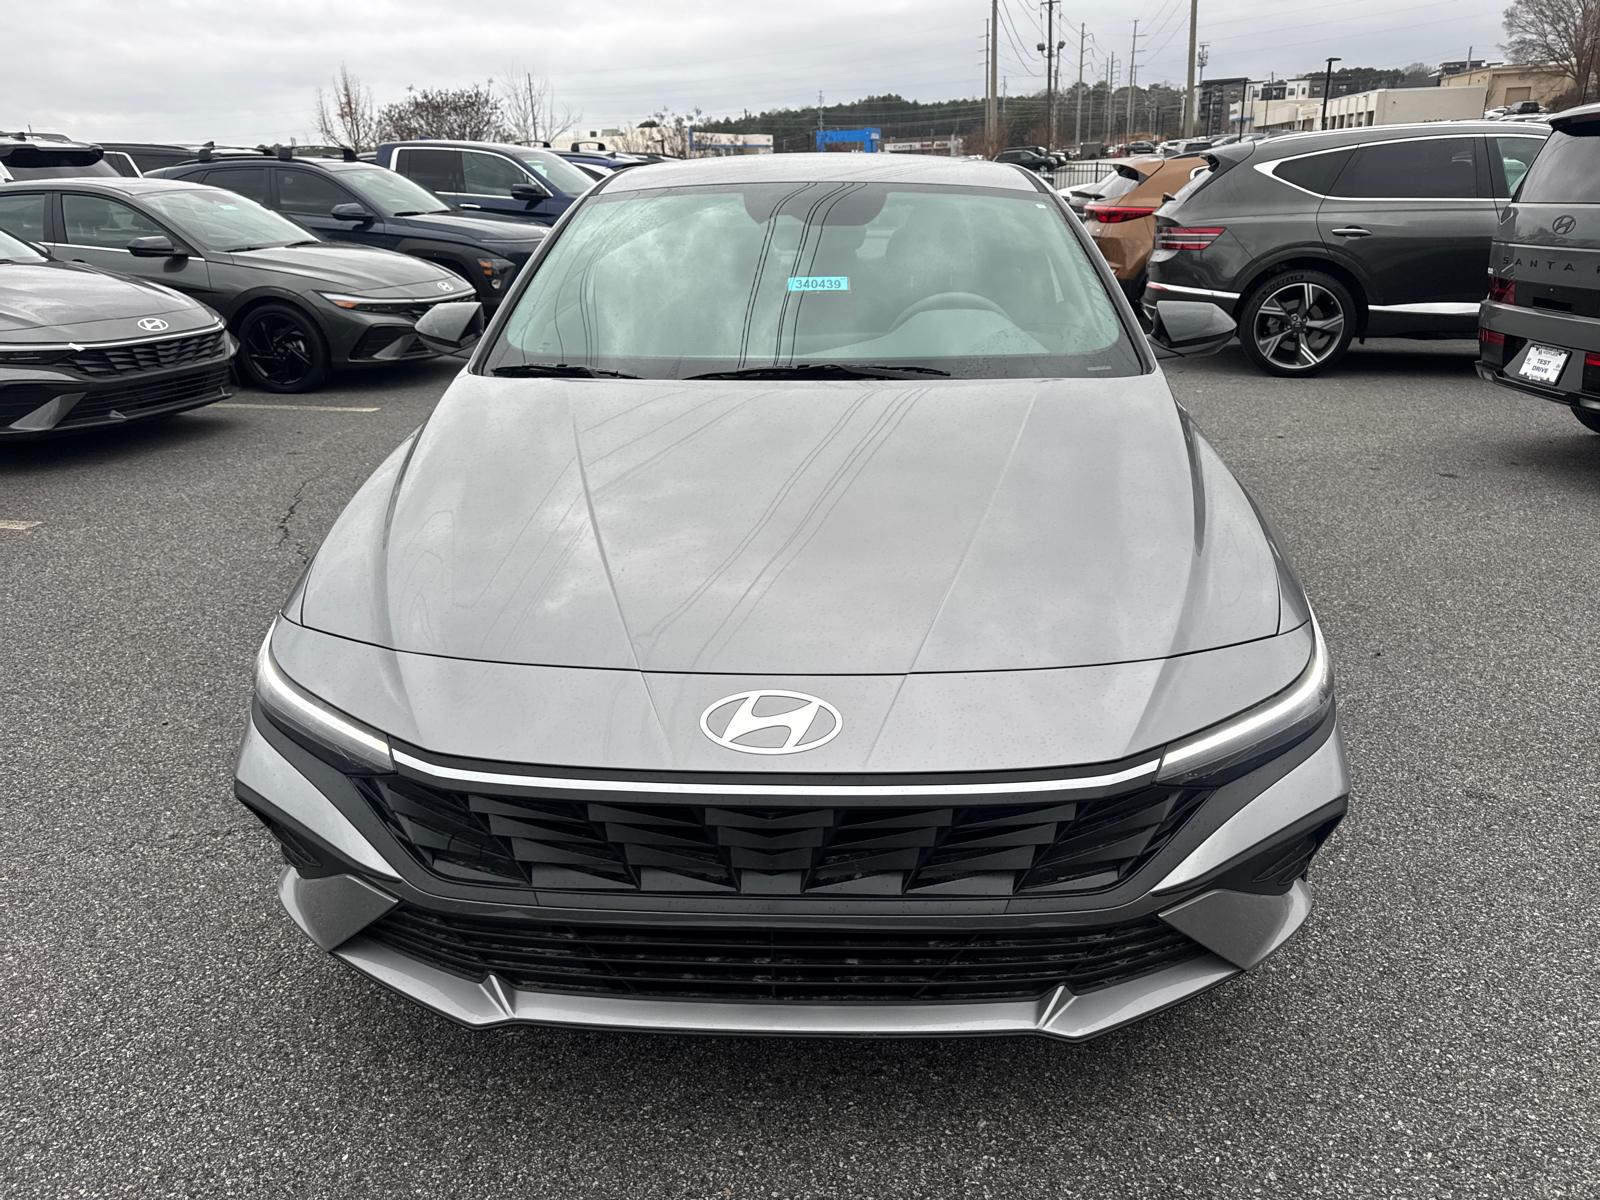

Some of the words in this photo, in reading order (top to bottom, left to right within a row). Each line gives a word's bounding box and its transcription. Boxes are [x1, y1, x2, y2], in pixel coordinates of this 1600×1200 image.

[1503, 256, 1575, 272] SANTA
[795, 279, 841, 289] 340439
[1537, 358, 1551, 366] TEST
[1532, 365, 1549, 374] DRIVE
